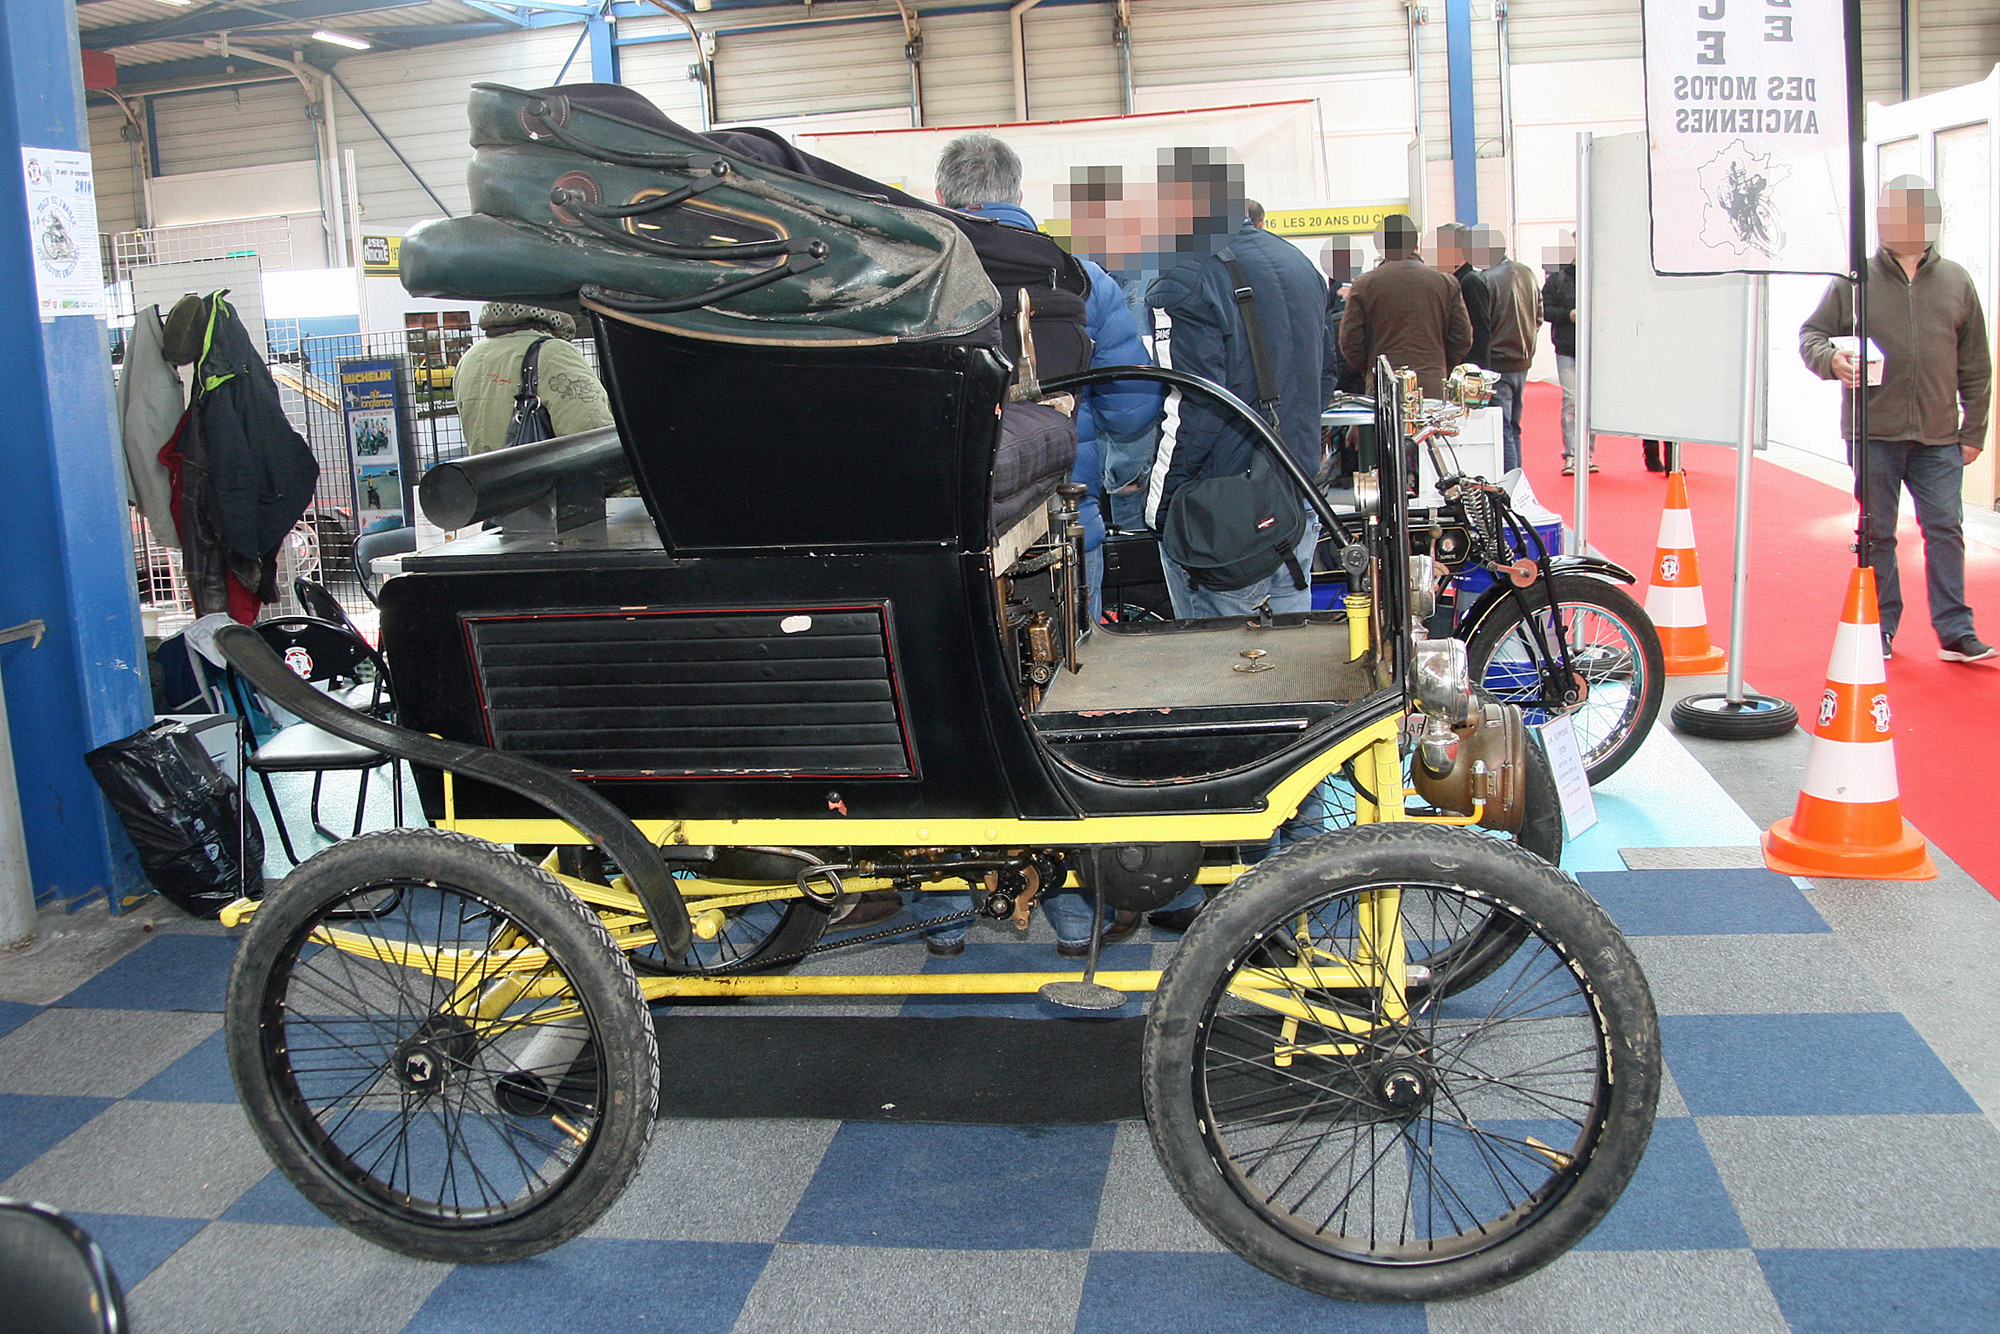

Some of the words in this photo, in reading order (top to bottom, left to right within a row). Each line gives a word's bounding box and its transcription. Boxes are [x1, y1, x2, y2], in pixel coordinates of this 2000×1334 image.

[75, 180, 92, 193] 2016
[1265, 219, 1276, 229] 16
[1283, 217, 1306, 228] LES
[1309, 216, 1322, 227] 20
[1325, 215, 1349, 226] ANS
[1353, 214, 1369, 225] DU
[342, 370, 392, 384] MICHELIN
